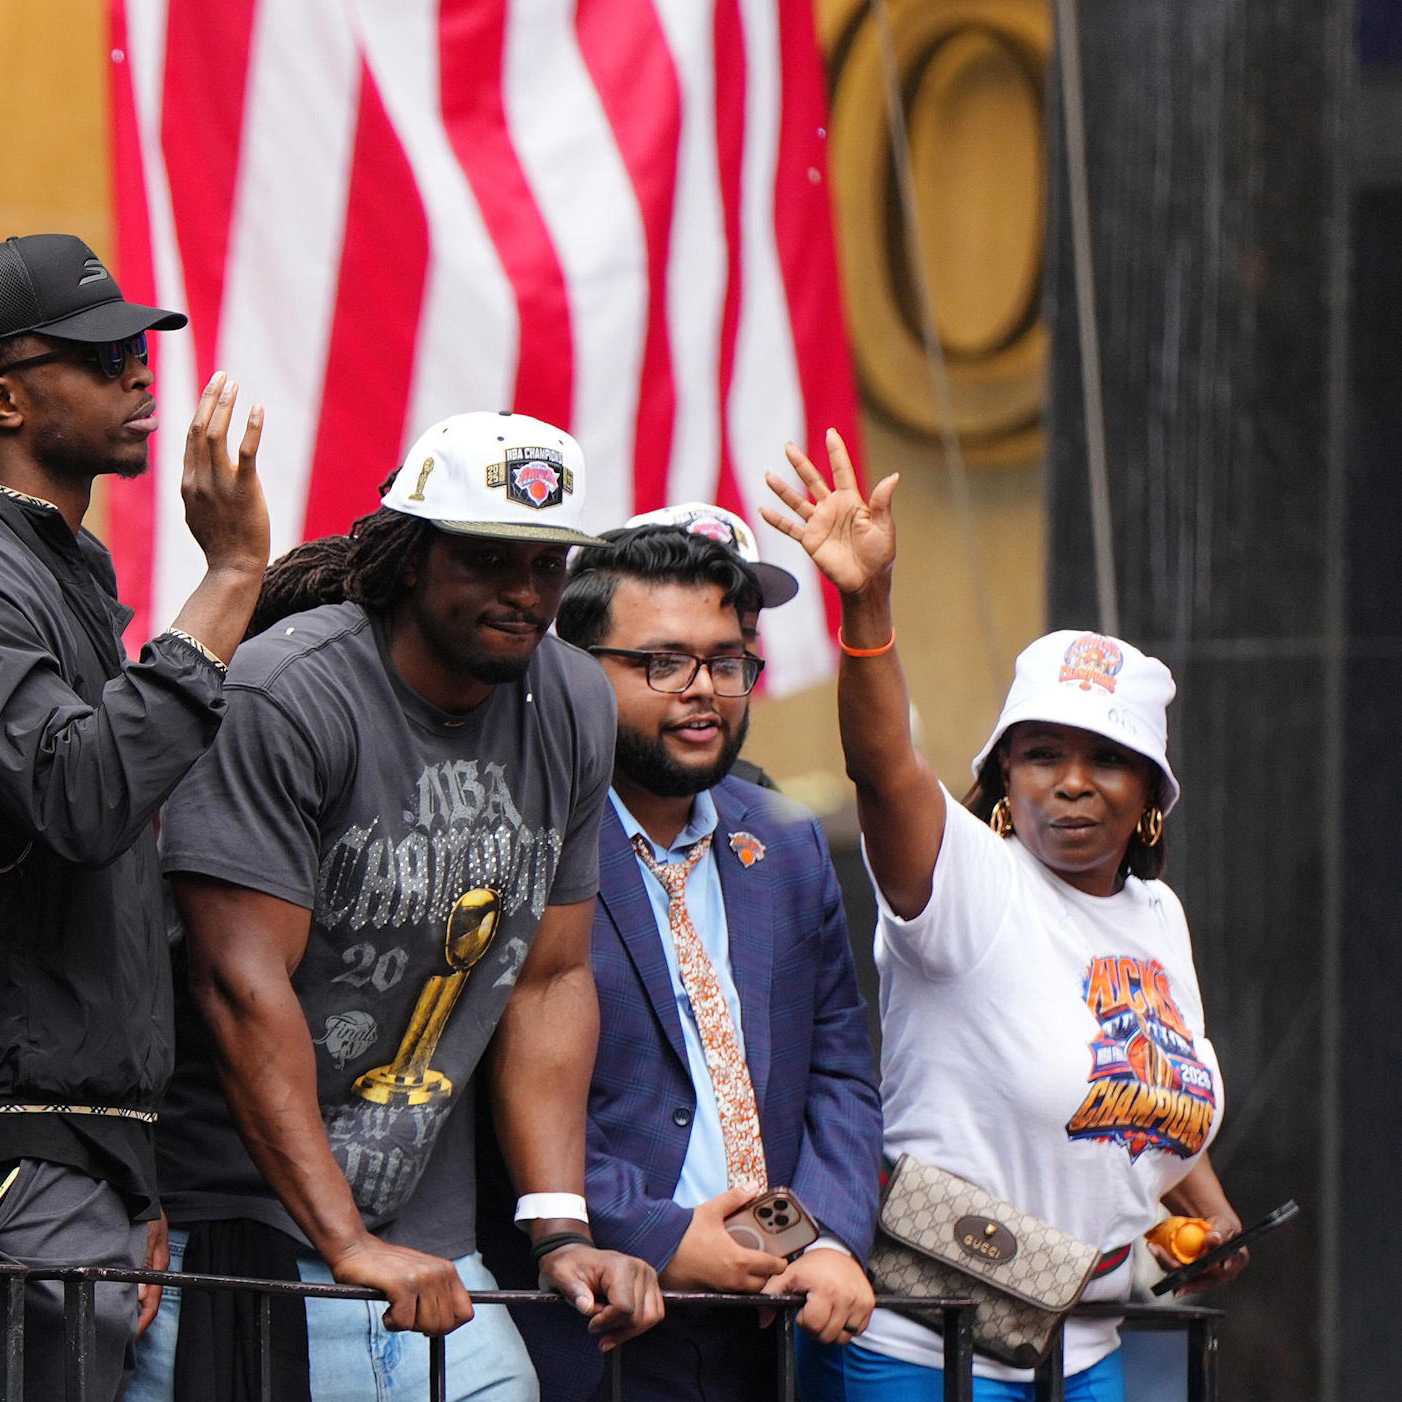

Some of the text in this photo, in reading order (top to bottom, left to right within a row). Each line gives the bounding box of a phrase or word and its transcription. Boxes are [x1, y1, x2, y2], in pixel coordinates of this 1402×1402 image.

[417, 760, 523, 831] NBA
[331, 936, 529, 992] 20 2
[313, 1013, 379, 1046] Finals
[1068, 1077, 1214, 1155] CHAMPIONS
[964, 1234, 1003, 1259] GUCCI
